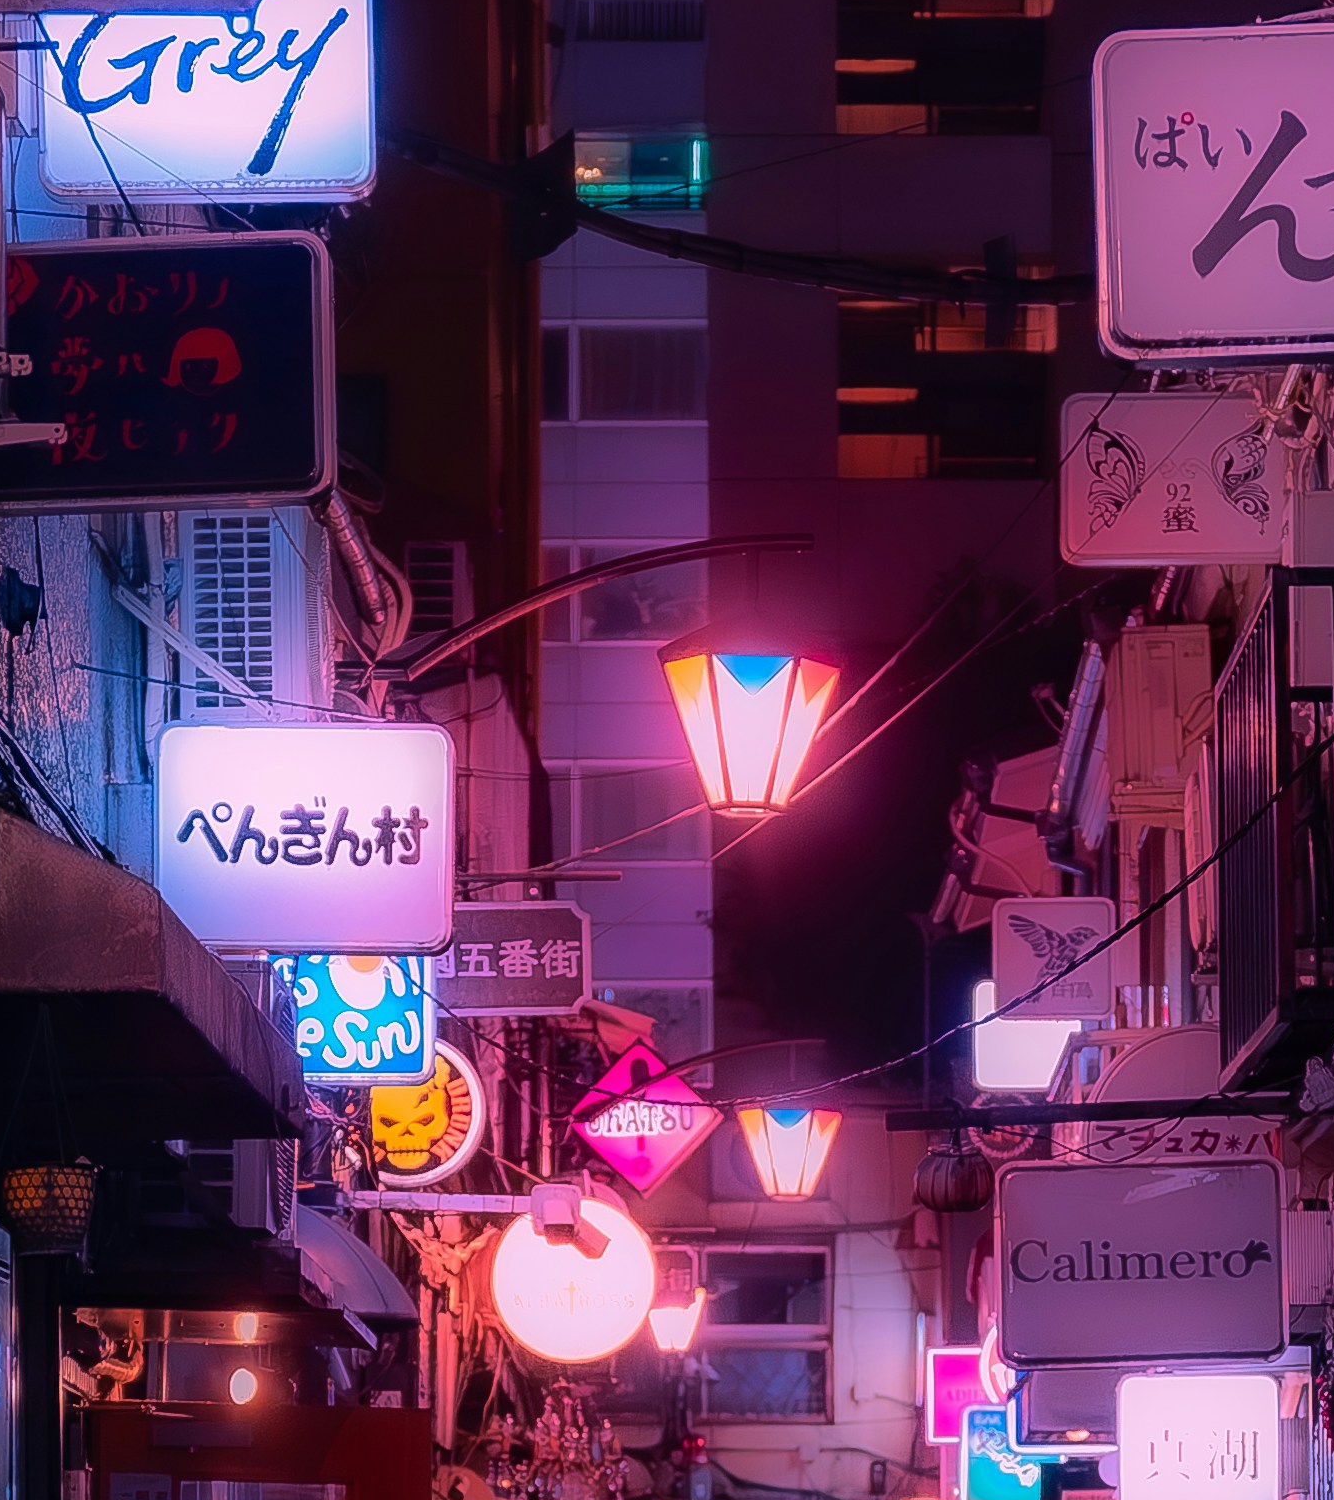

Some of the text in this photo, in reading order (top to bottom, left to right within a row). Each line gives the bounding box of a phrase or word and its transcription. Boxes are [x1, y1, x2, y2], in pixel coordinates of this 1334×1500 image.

[64, 9, 350, 177] Grey
[1165, 482, 1192, 502] 92
[176, 796, 429, 868] ぺんぎん村
[436, 936, 581, 982] 五番街
[1009, 1236, 1257, 1284] Calimero
